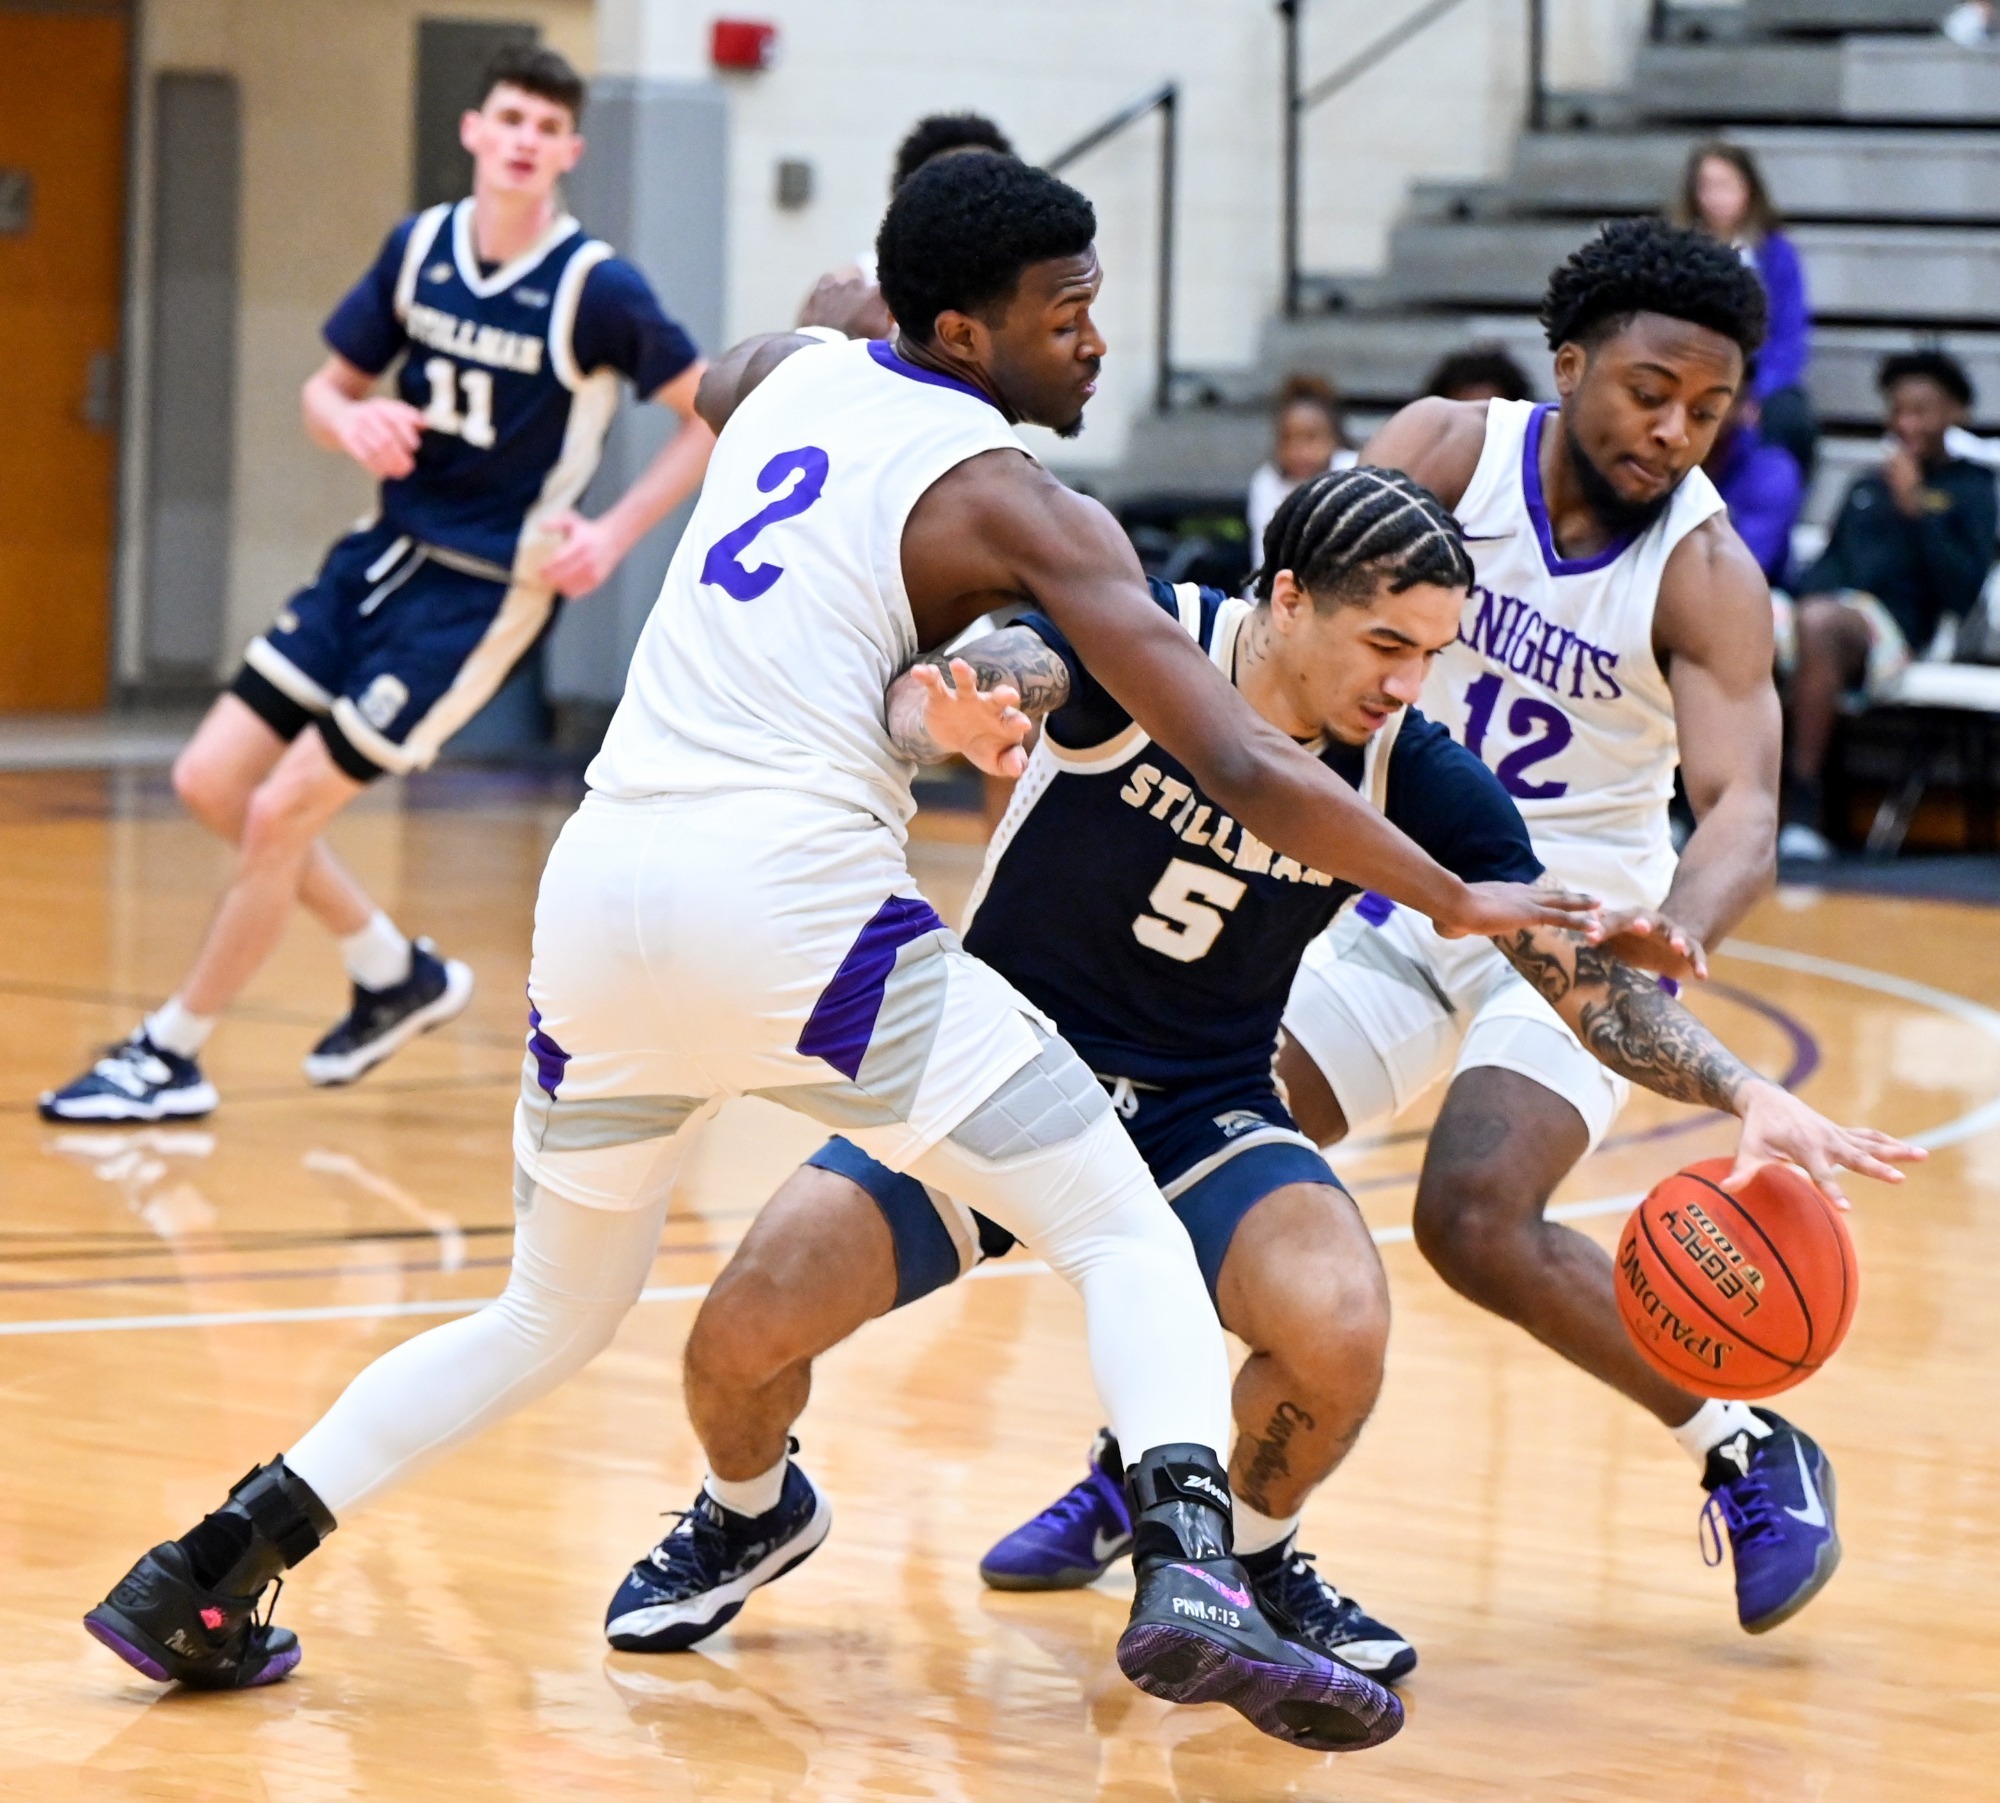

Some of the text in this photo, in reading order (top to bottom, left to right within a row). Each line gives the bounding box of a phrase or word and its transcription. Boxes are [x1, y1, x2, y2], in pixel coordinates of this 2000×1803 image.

[424, 355, 496, 450] 11
[699, 445, 829, 602] 2
[1458, 585, 1622, 700] NIGHTS
[1464, 671, 1574, 799] 12
[1131, 857, 1248, 963] 5
[1659, 1211, 1759, 1317] LEGACY
[1686, 1203, 1742, 1264] 1000
[1621, 1237, 1733, 1369] SPALDING
